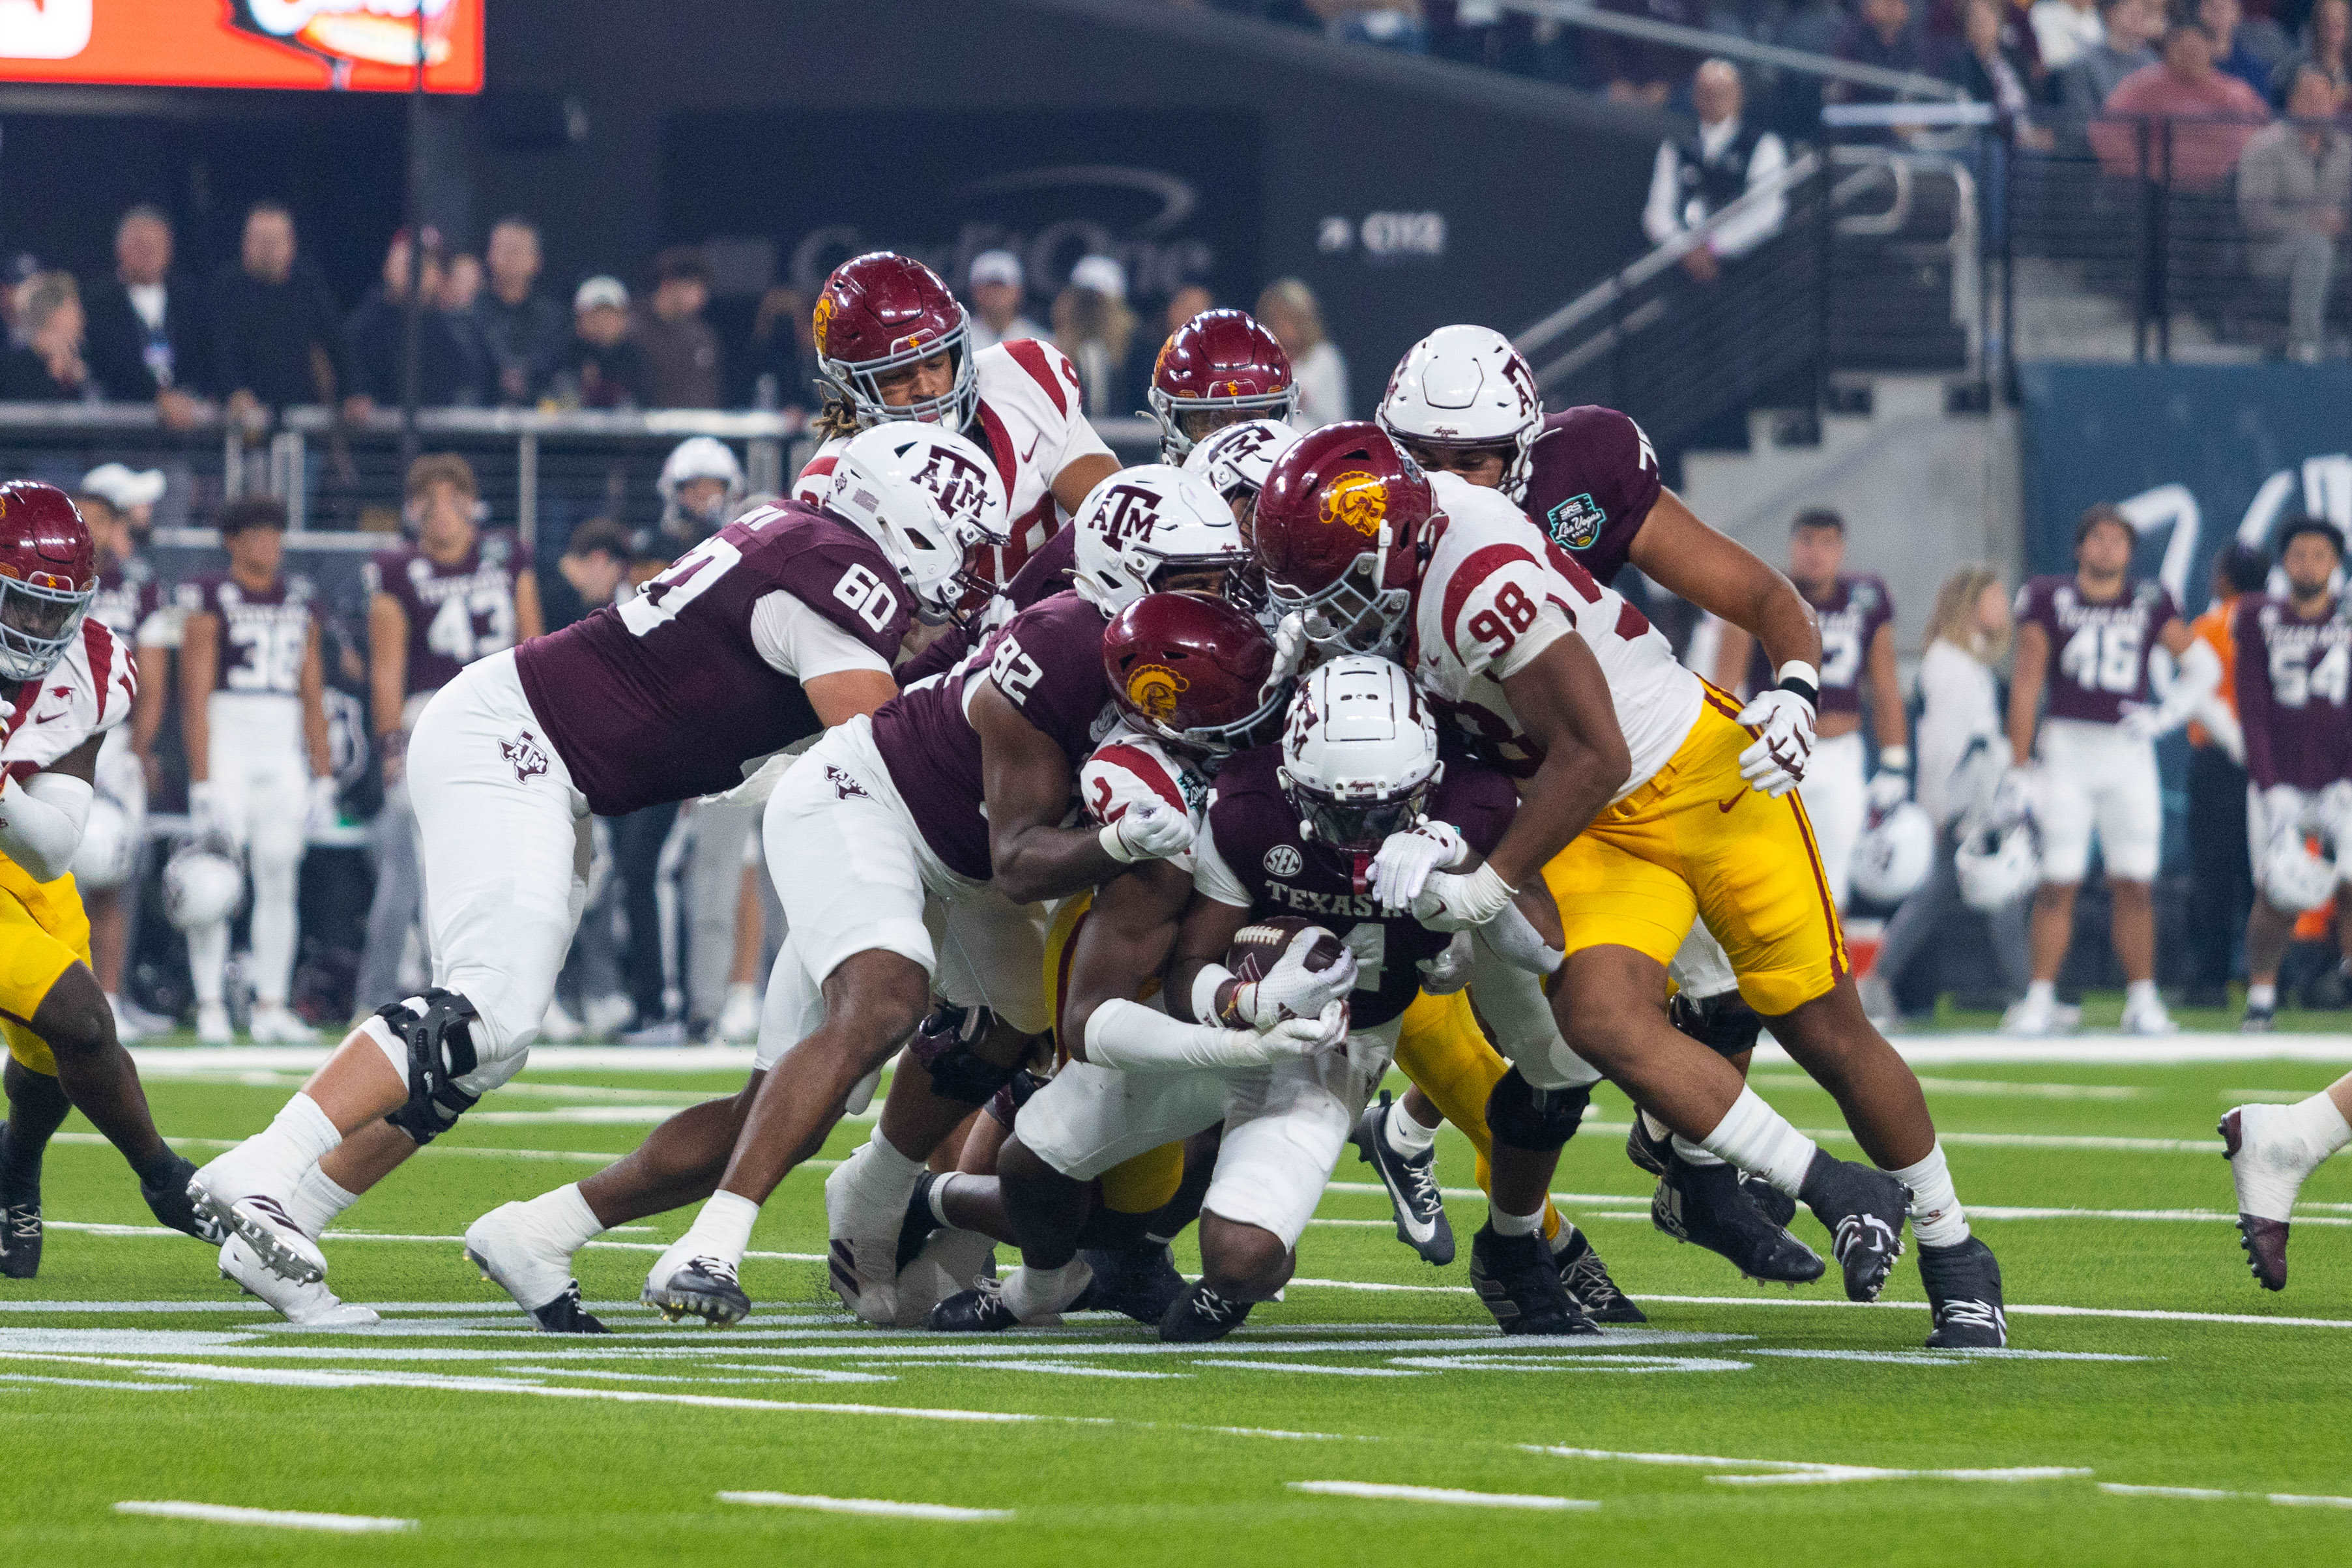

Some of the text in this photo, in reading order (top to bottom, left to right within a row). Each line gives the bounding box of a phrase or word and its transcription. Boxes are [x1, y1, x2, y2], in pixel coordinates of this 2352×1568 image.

[1555, 521, 1575, 540] Las
[1571, 512, 1601, 530] Vegas
[427, 588, 515, 661] 43
[832, 562, 898, 633] 60
[1468, 581, 1537, 659] 98
[990, 633, 1043, 706] 82
[2061, 620, 2140, 693] 46
[2271, 642, 2350, 708] 54
[1266, 847, 1299, 874] SEC
[1264, 879, 1374, 917] TEXAS
